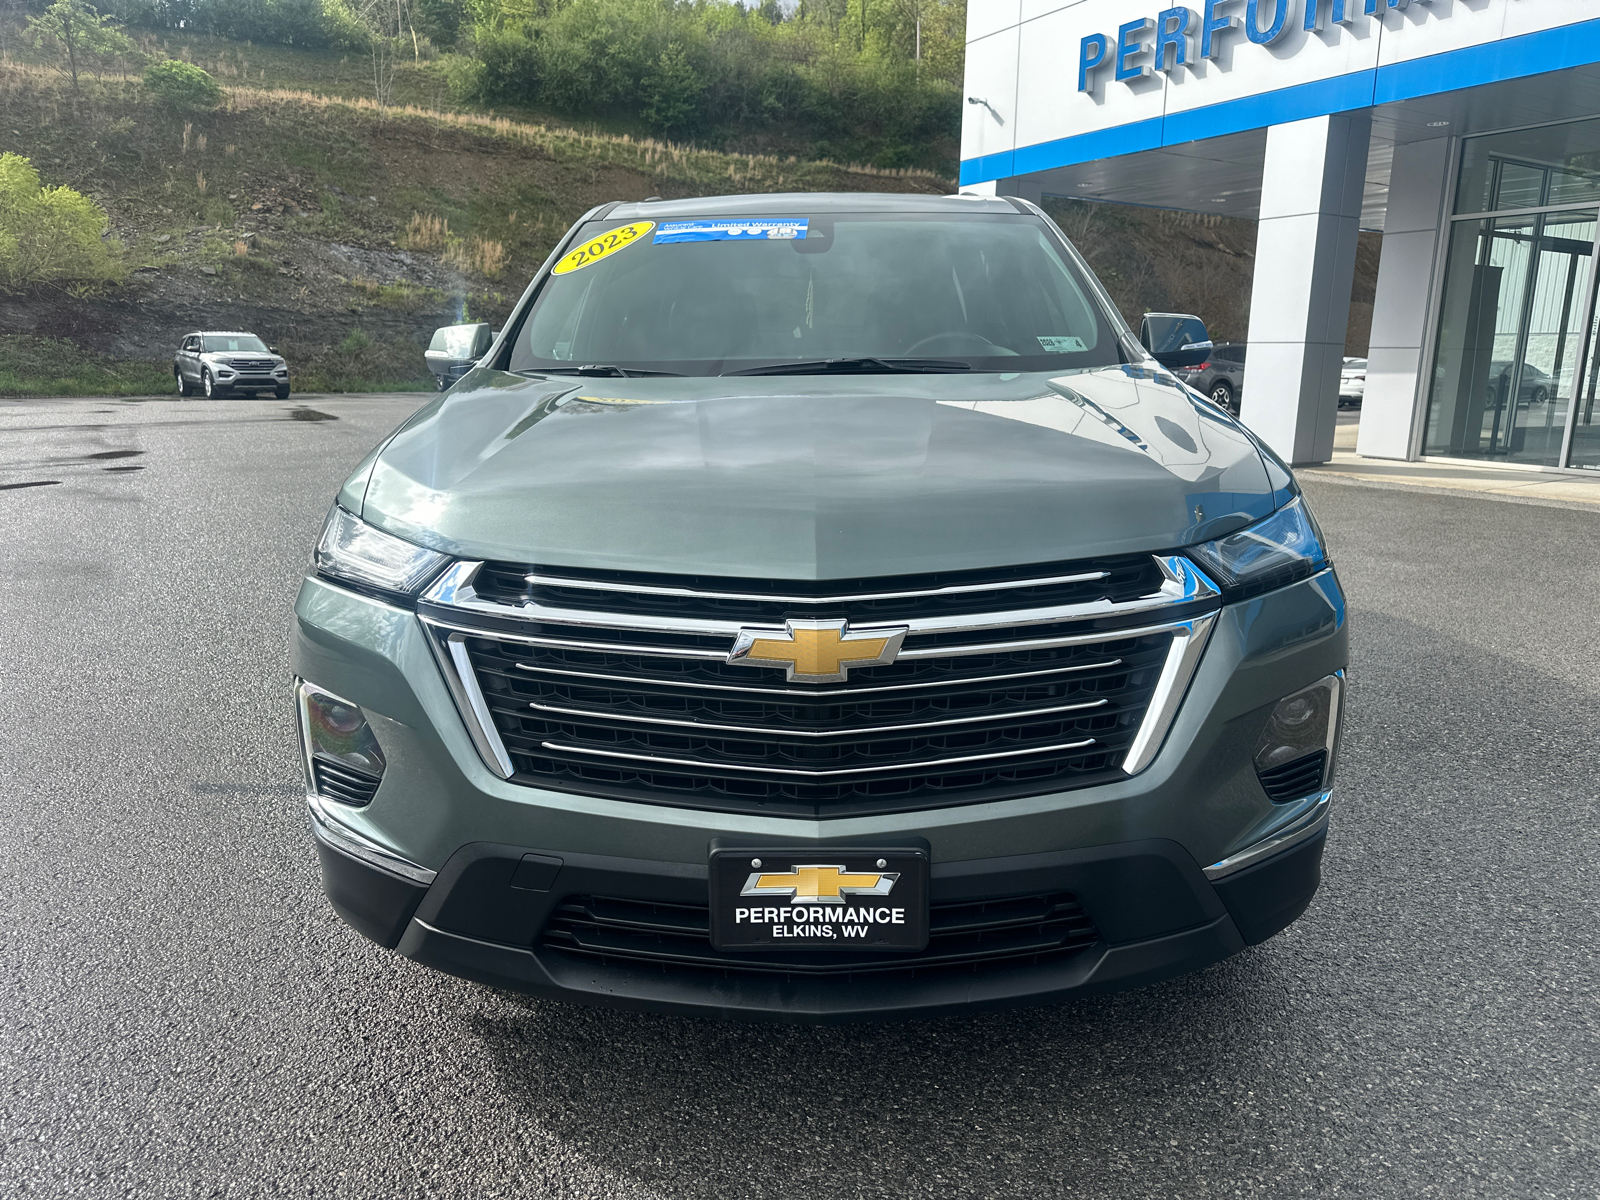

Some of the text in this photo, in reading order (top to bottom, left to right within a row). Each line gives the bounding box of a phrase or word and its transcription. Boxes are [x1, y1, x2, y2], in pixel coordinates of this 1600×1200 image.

[572, 227, 637, 266] 2023
[736, 907, 905, 923] PERFORMANCE
[772, 925, 868, 939] ELKINS, WV
